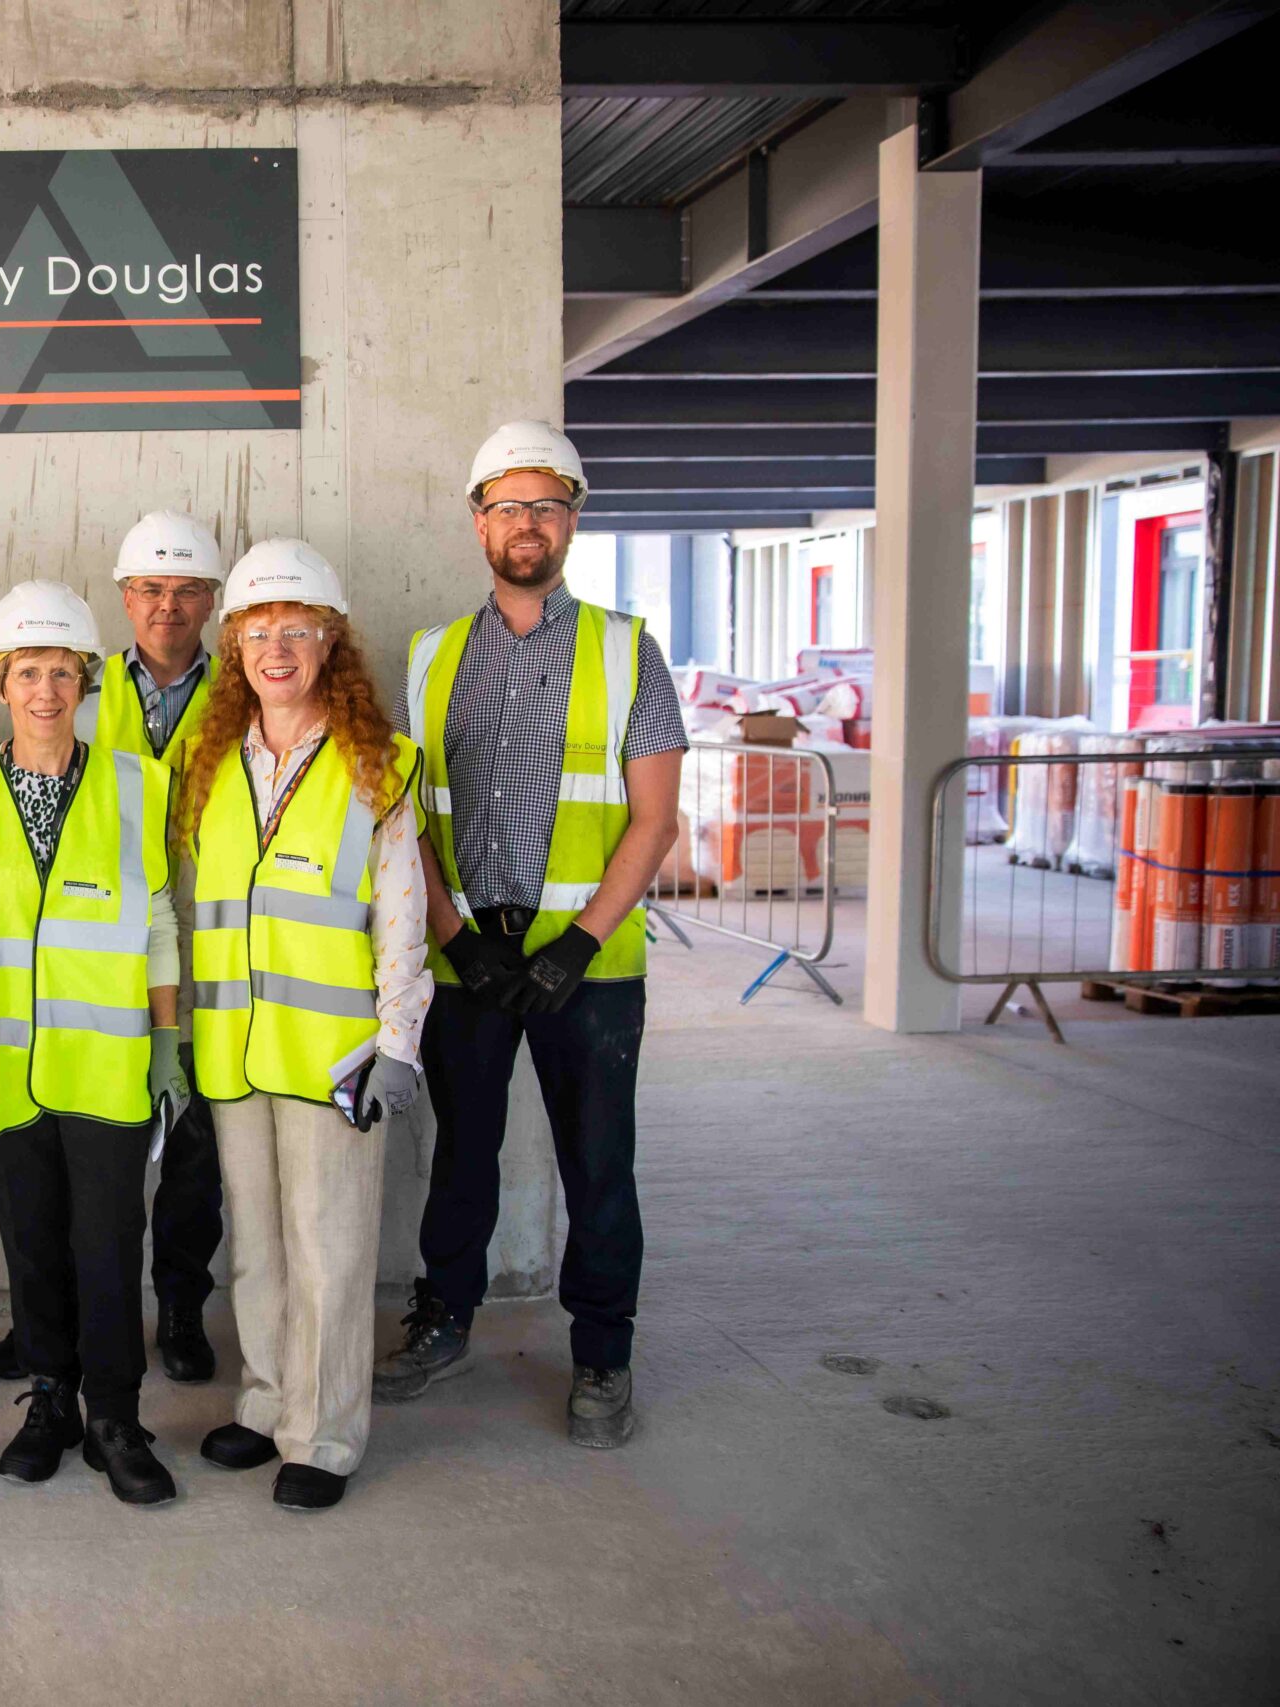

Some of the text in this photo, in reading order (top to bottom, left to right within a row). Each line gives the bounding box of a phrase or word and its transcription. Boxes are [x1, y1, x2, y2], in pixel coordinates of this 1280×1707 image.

[47, 254, 263, 304] Douglas
[276, 573, 302, 581] Douglas
[45, 619, 70, 628] Douglas
[1228, 883, 1240, 907] KSK
[1223, 928, 1234, 970] AUDER
